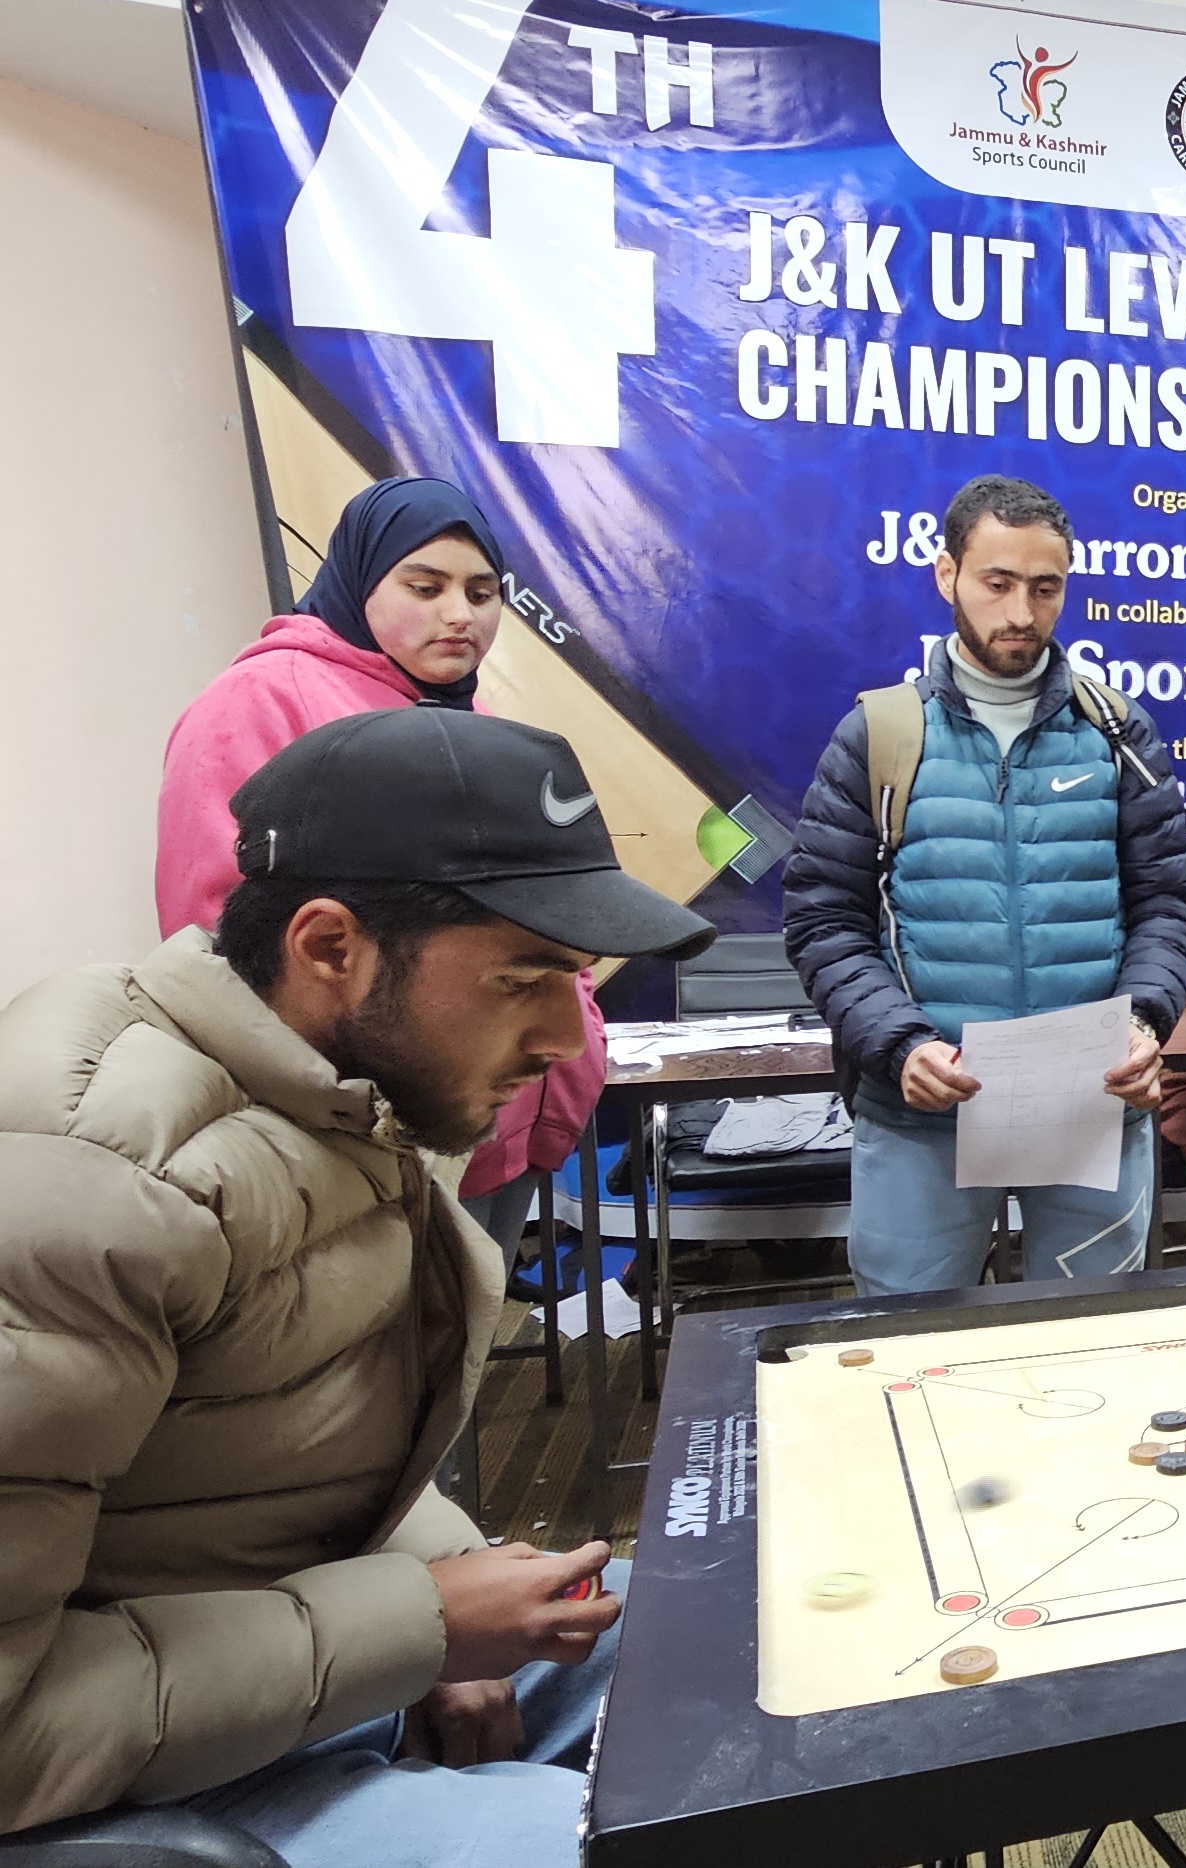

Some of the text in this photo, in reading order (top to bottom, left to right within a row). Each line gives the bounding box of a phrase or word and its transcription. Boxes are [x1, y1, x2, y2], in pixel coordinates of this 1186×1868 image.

[949, 122, 1108, 156] Jammu & Kashmir
[972, 146, 1087, 174] Sports Council
[739, 210, 902, 314] J&K
[931, 231, 1036, 326] UT
[866, 510, 945, 567] J&
[1086, 598, 1110, 621] In
[665, 1476, 712, 1536] SYNCO
